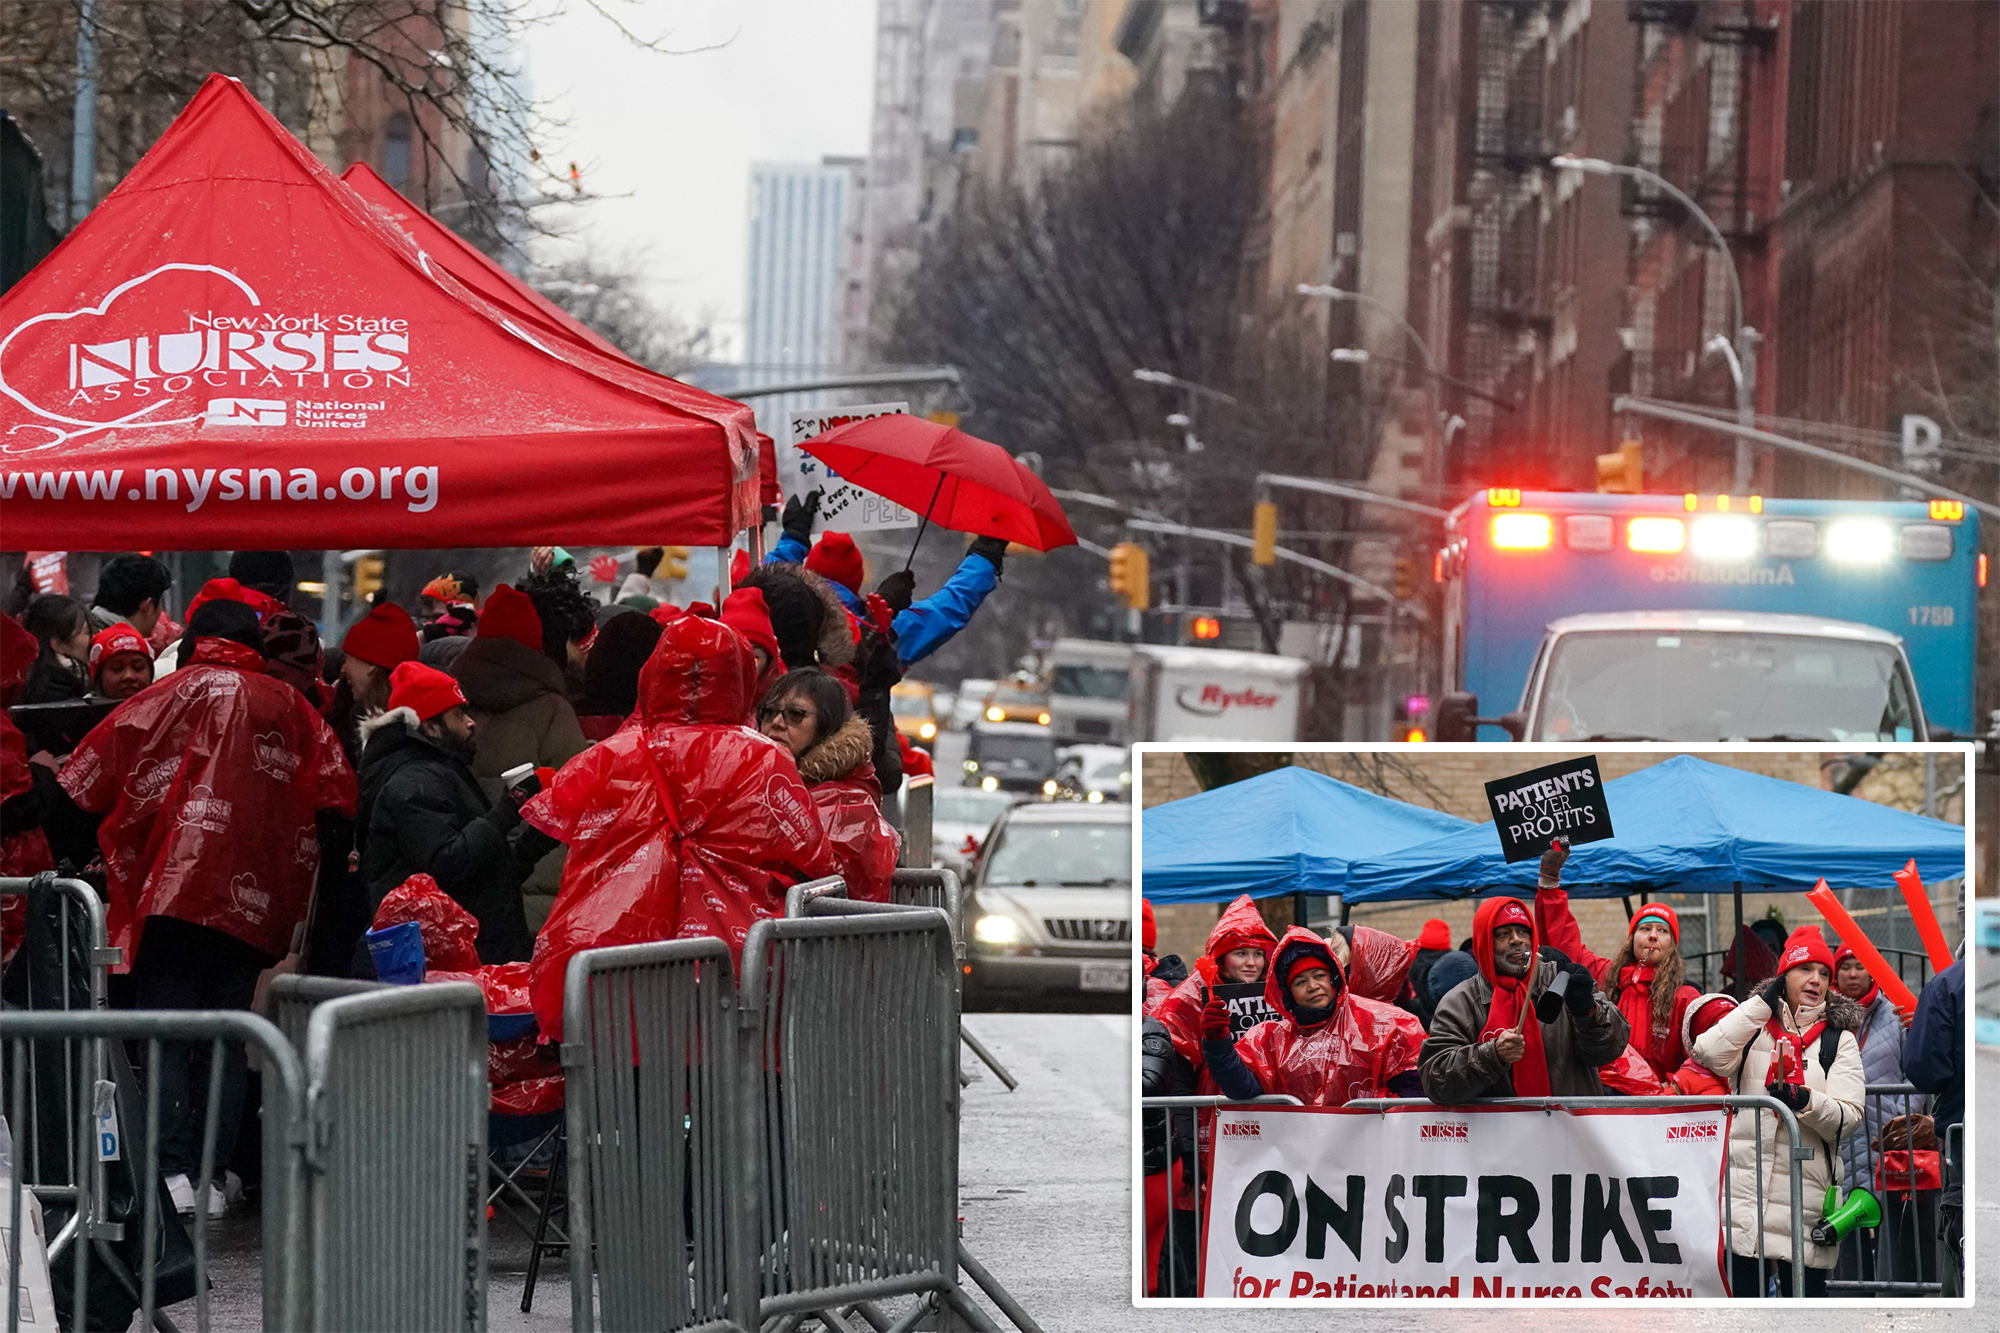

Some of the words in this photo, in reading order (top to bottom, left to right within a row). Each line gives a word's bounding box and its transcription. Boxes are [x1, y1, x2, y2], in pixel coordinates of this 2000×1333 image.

[189, 310, 258, 331] New
[263, 313, 330, 331] York
[337, 314, 409, 332] State
[69, 329, 409, 389] NURSES
[68, 370, 411, 406] ASSOCIATION
[296, 401, 385, 411] National
[296, 410, 369, 420] Nurses
[296, 419, 367, 429] United
[792, 418, 816, 434] I'm
[828, 485, 849, 504] even
[823, 499, 849, 521] have
[1908, 605, 1954, 626] 1759
[1201, 685, 1278, 713] Ryder
[1495, 768, 1595, 813] PATIENTS
[1522, 794, 1571, 820] OVER
[1508, 805, 1596, 844] PROFITS
[1220, 995, 1276, 1017] ATIE
[1222, 1124, 1261, 1135] NURSES
[1420, 1125, 1469, 1137] NURSES
[1665, 1135, 1718, 1143] ASSOCIATION
[1666, 1125, 1718, 1138] NURSES
[1235, 1170, 1365, 1262] ON
[1385, 1173, 1682, 1264] STRIKE
[1234, 1267, 1281, 1298] for
